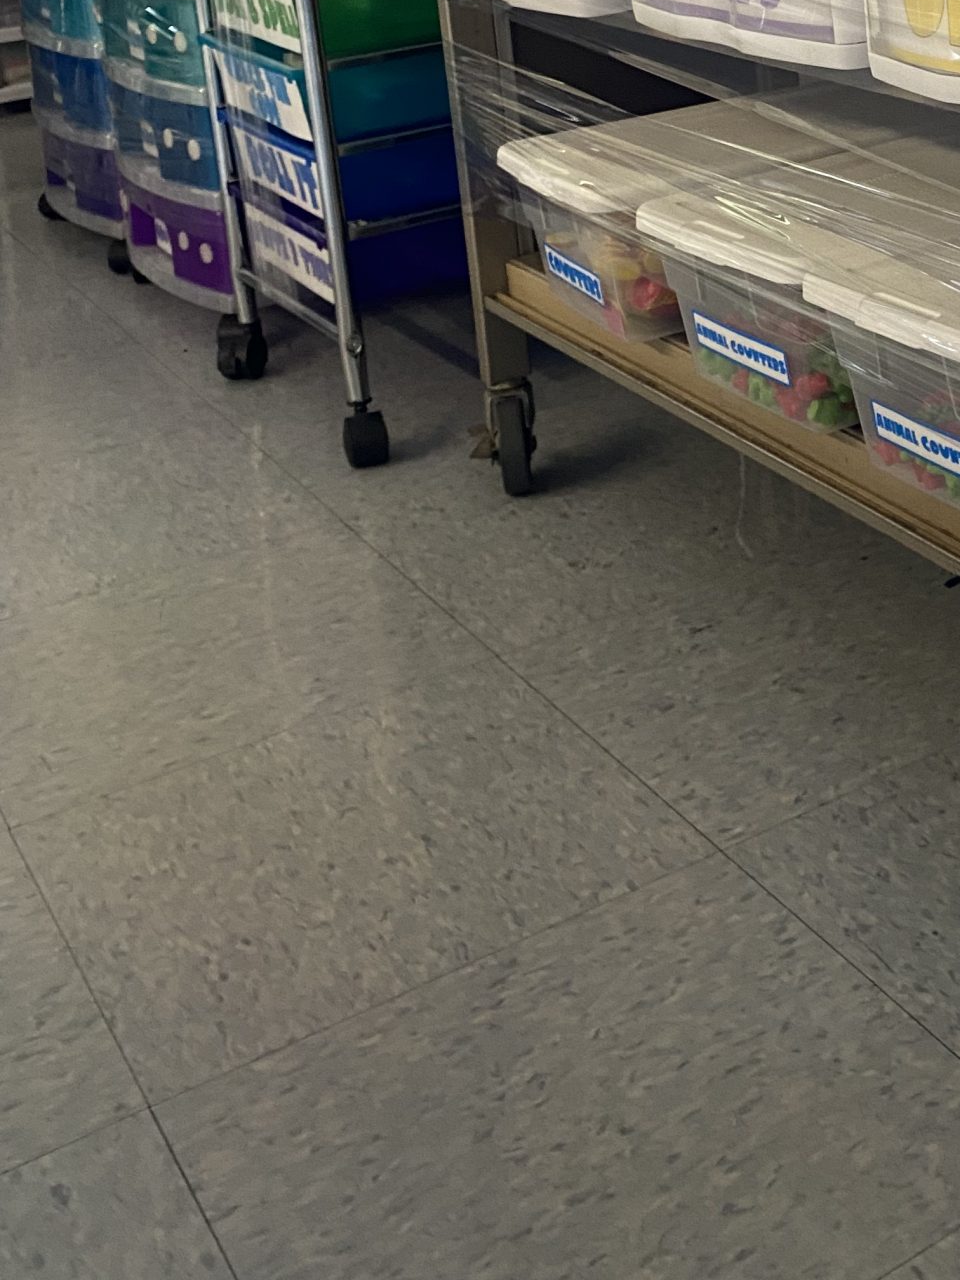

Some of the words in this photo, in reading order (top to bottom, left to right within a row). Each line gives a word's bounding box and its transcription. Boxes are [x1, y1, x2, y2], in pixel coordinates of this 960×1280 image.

[548, 251, 601, 301] COUNTERS
[730, 340, 787, 375] COUNTERS
[876, 412, 919, 446] ANIMAL
